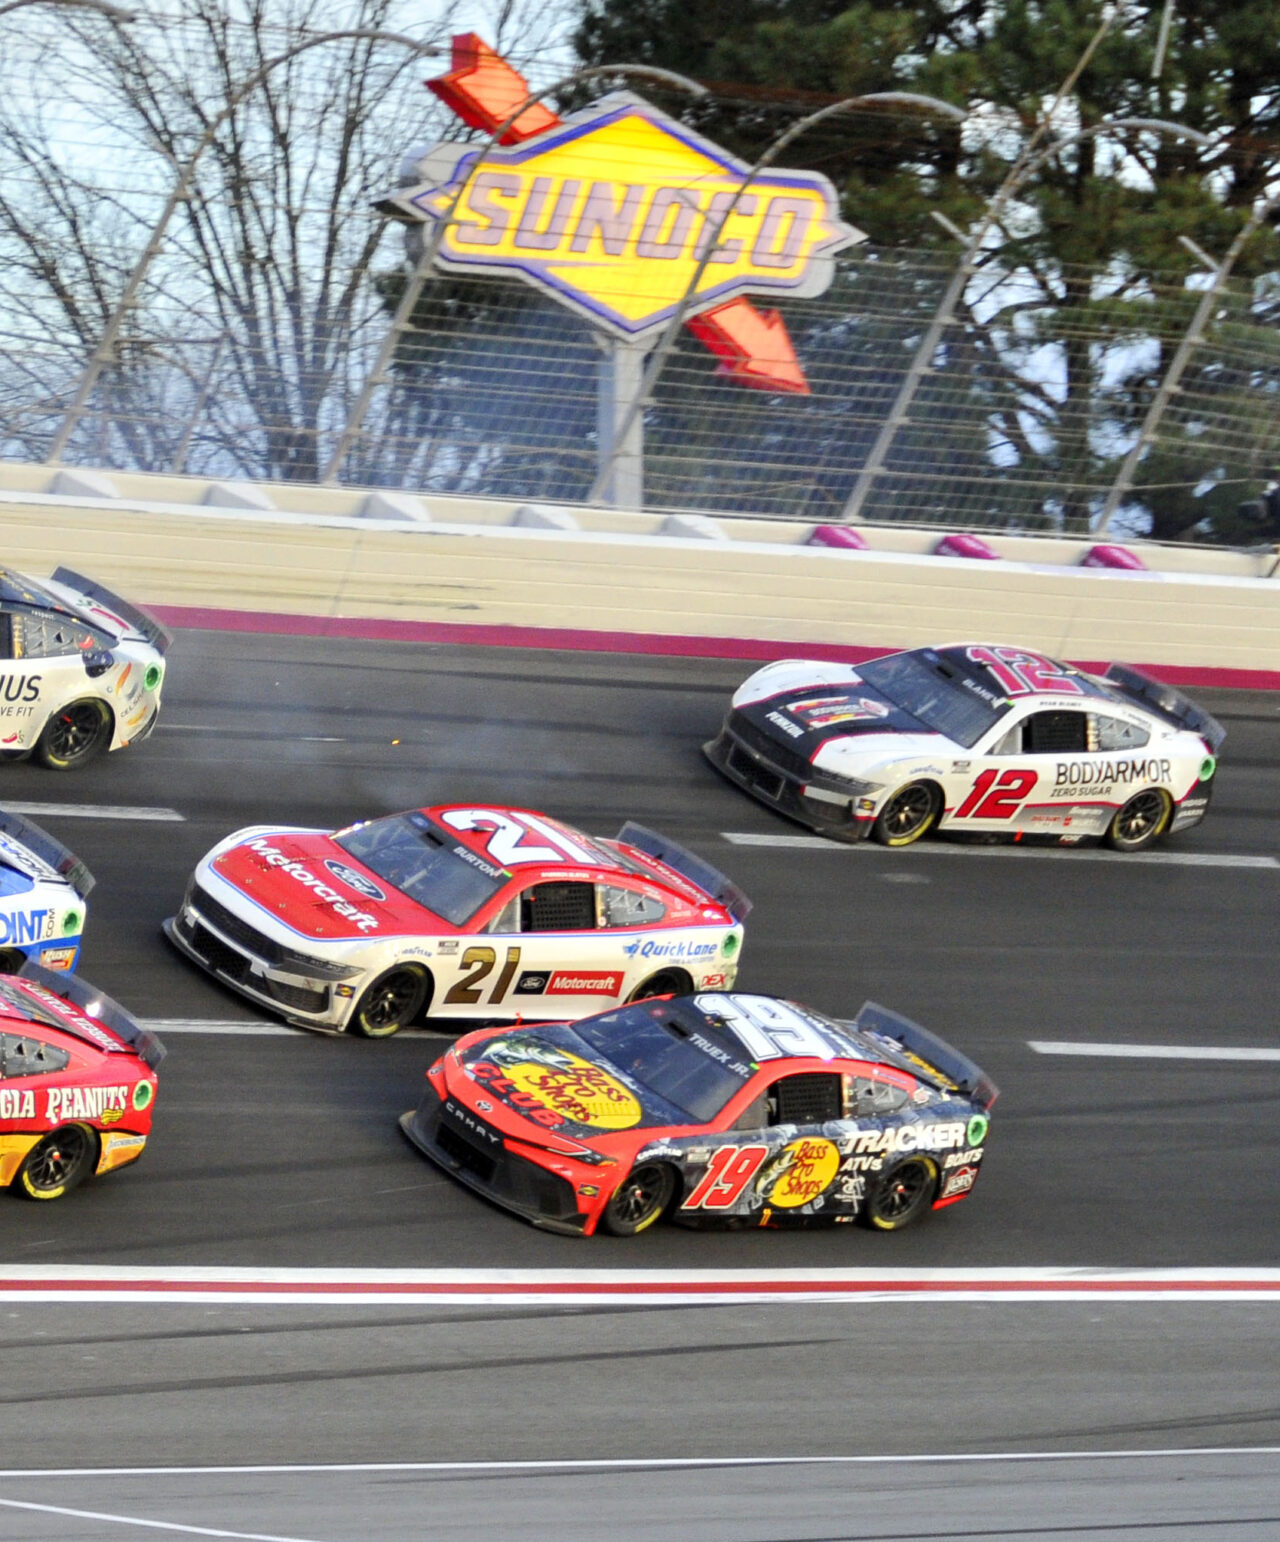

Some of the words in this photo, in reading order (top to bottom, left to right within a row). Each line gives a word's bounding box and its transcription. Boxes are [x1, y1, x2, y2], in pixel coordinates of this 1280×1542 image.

[456, 172, 828, 269] SUNOCO
[966, 646, 1085, 696] 12
[16, 706, 34, 718] FIT
[1055, 758, 1172, 787] BODYARMOR
[953, 768, 1039, 820] 12
[1049, 786, 1078, 798] ZERO
[1078, 785, 1113, 798] SUGAR
[441, 808, 600, 866] 21
[453, 845, 504, 879] BURTON
[245, 838, 381, 934] Motorcraft
[640, 940, 685, 959] Quick
[687, 941, 718, 956] Lane
[442, 946, 521, 1005] 21
[552, 976, 616, 990] Motorcraft
[688, 1033, 730, 1065] TRUEX
[727, 1061, 750, 1079] JR.
[45, 1085, 129, 1121] PEANUTS
[471, 1062, 565, 1128] CLUB
[445, 1101, 501, 1145] CAMRY
[840, 1122, 966, 1154] TRACKER
[793, 1141, 829, 1160] Bass
[838, 1156, 883, 1172] ATVs
[944, 1147, 985, 1169] BOATS
[680, 1144, 769, 1210] 19
[781, 1177, 823, 1200] Shops
